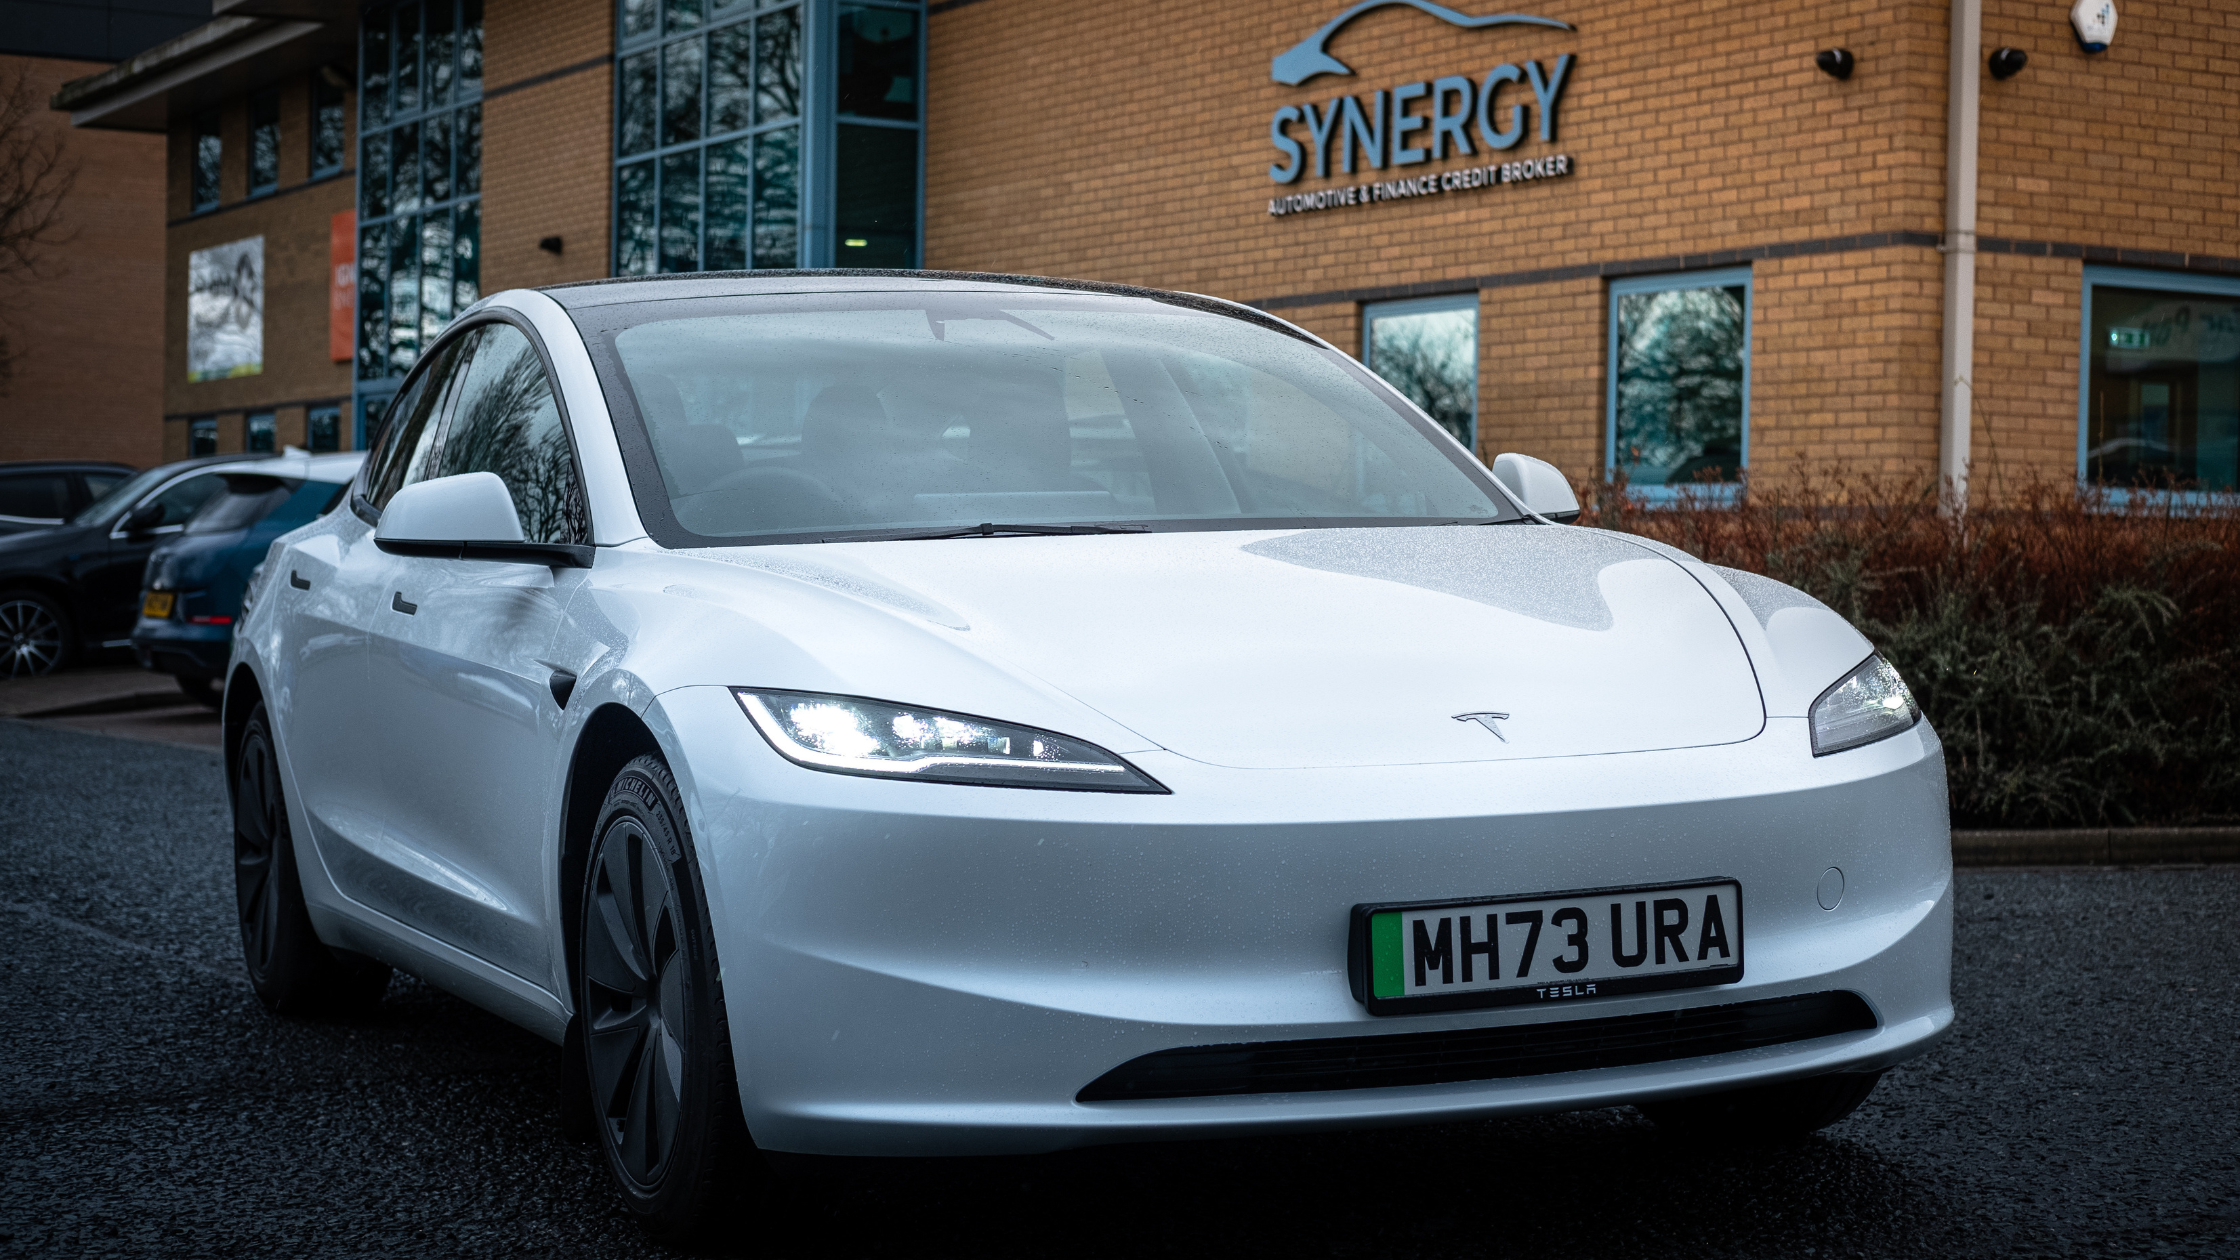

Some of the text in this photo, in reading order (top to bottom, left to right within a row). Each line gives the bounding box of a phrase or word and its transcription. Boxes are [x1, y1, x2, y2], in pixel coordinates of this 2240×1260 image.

[1269, 53, 1573, 183] SYNERGY
[1268, 154, 1569, 215] AUTOMOTIVE & FINANCE CREDIT BROKER
[616, 777, 656, 807] MICHELIN
[1412, 894, 1731, 986] MH73 URA
[1536, 984, 1597, 999] TESLA
